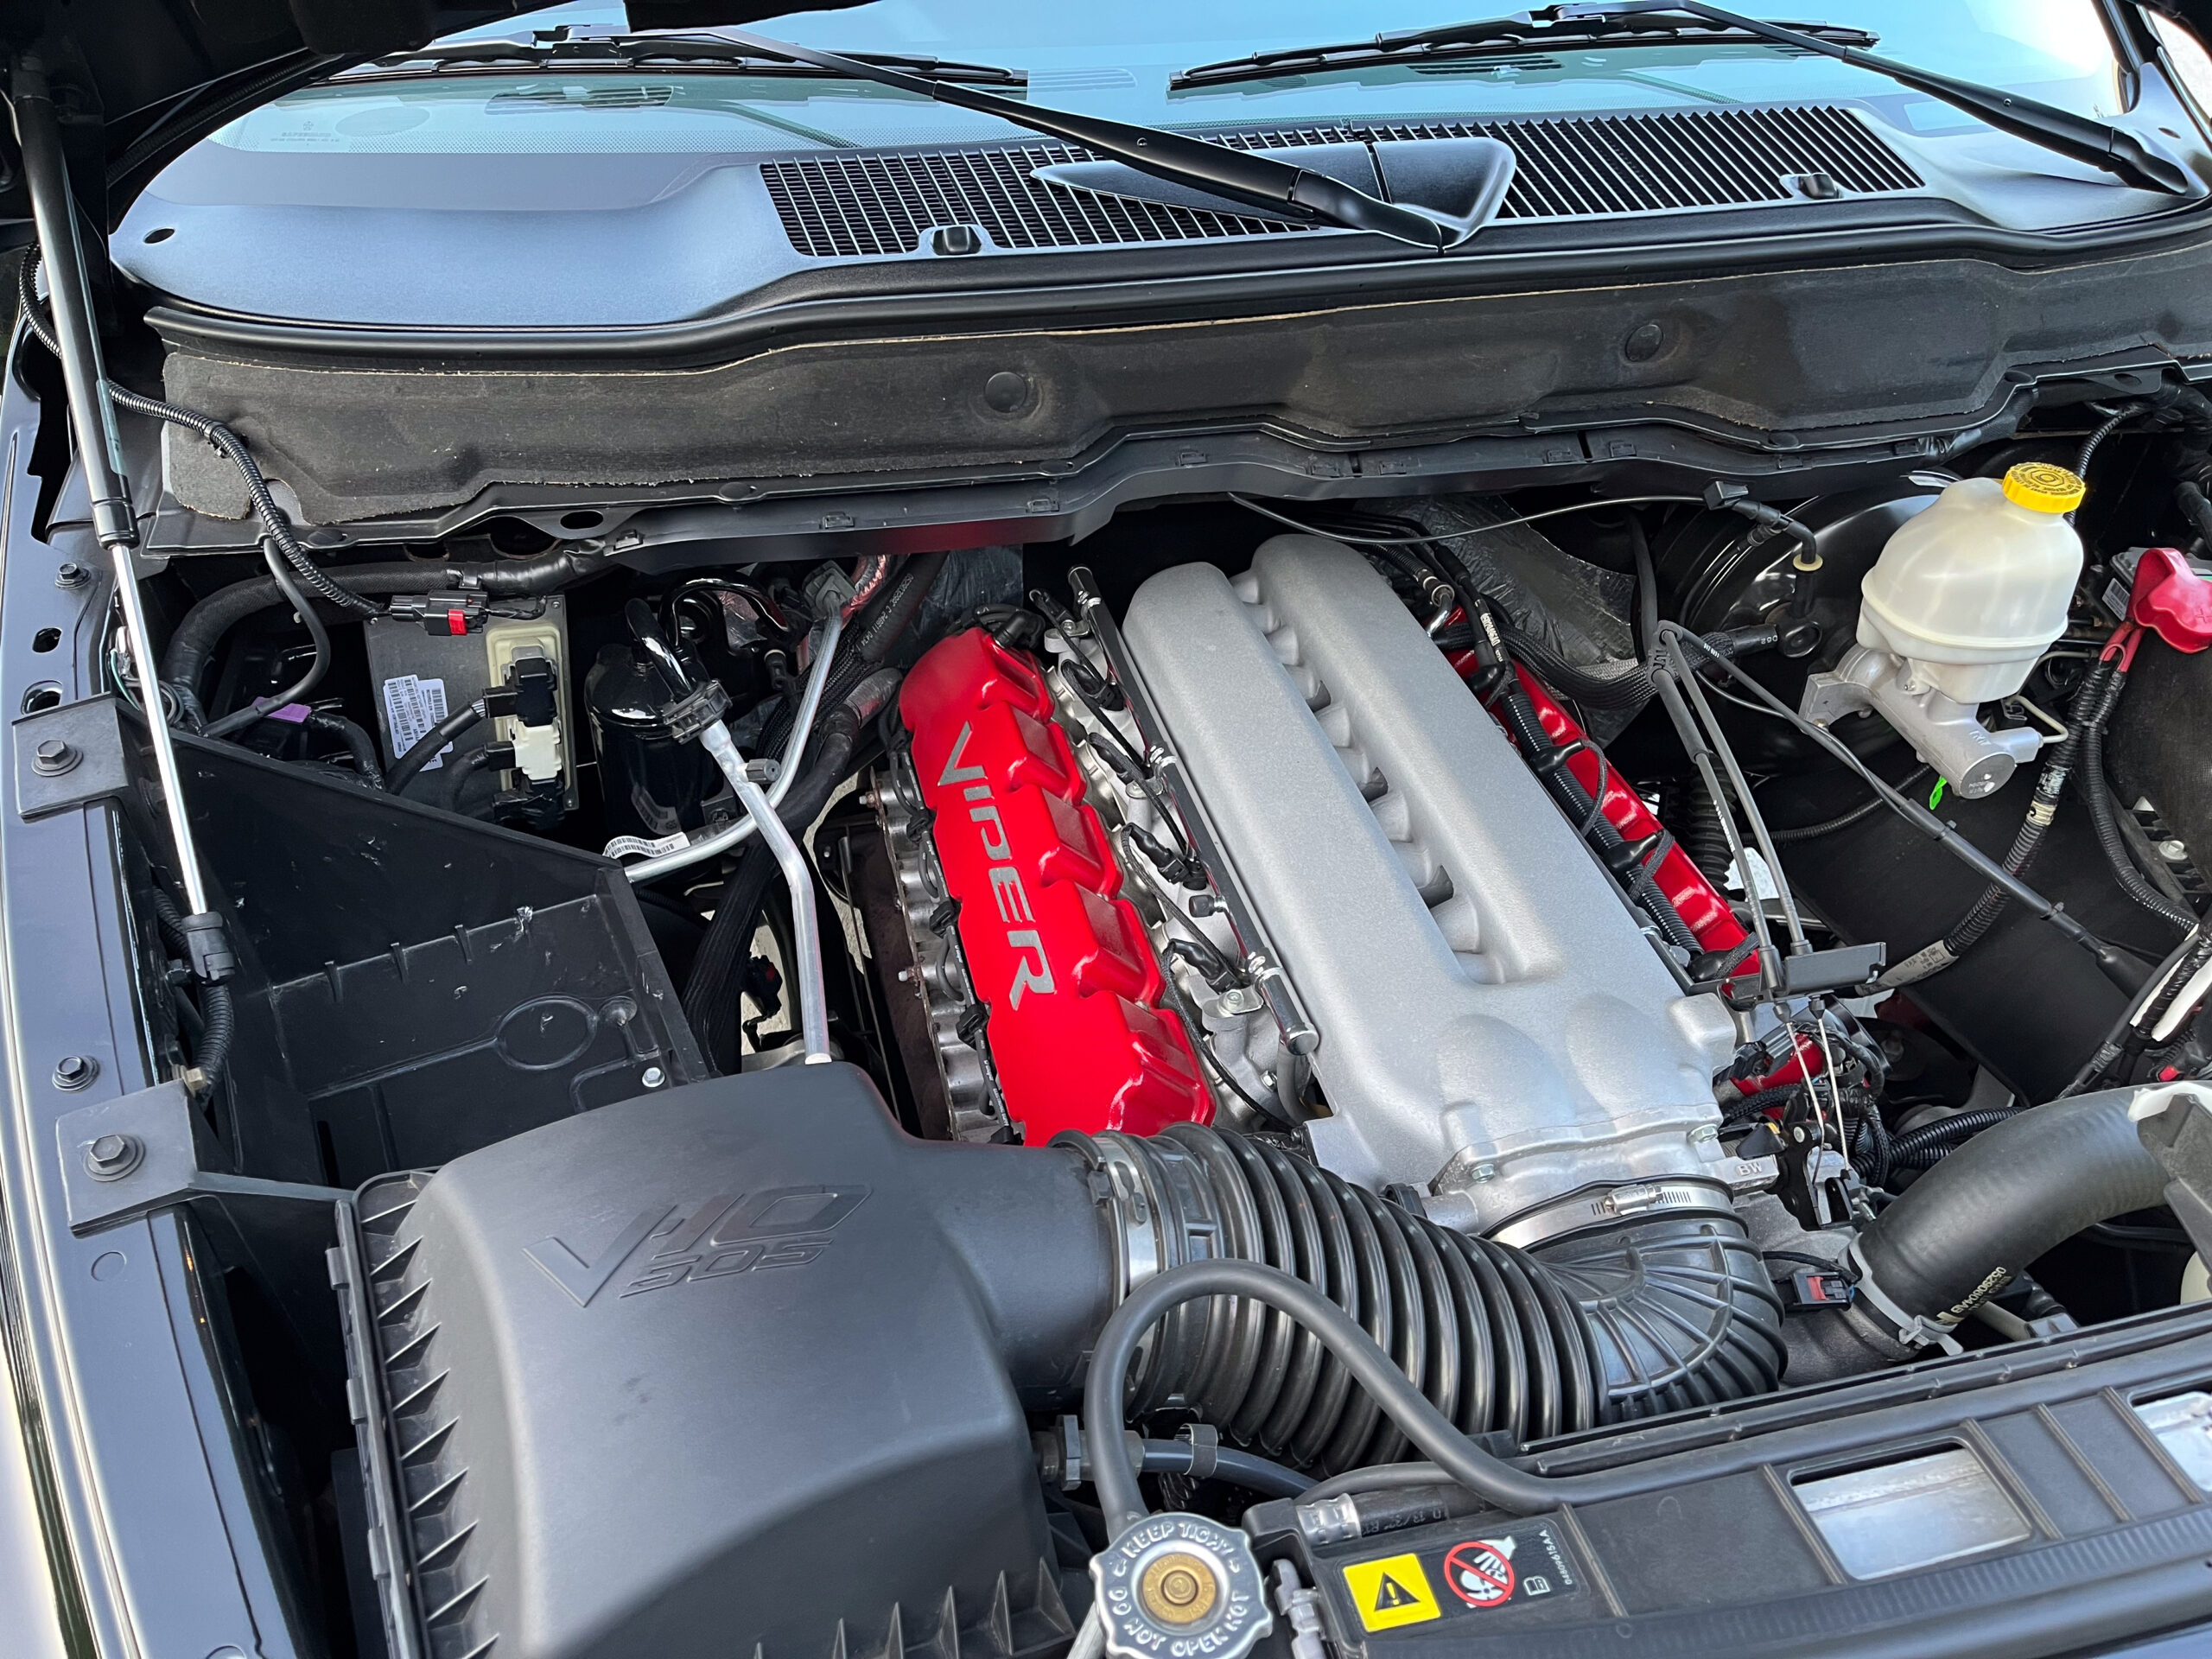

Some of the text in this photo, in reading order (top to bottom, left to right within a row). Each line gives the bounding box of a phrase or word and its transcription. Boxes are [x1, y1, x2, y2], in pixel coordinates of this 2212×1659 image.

[938, 721, 1058, 1011] VIPER
[1737, 1161, 1763, 1176] BW
[522, 1185, 874, 1308] V10
[618, 1238, 834, 1299] 505
[1950, 1267, 2006, 1313] 05290804AB
[1121, 1522, 1235, 1559] KEEP TIGHT
[1539, 1529, 1573, 1585] 04809615AA
[1109, 1586, 1250, 1657] DO NOT OPEN HOT
